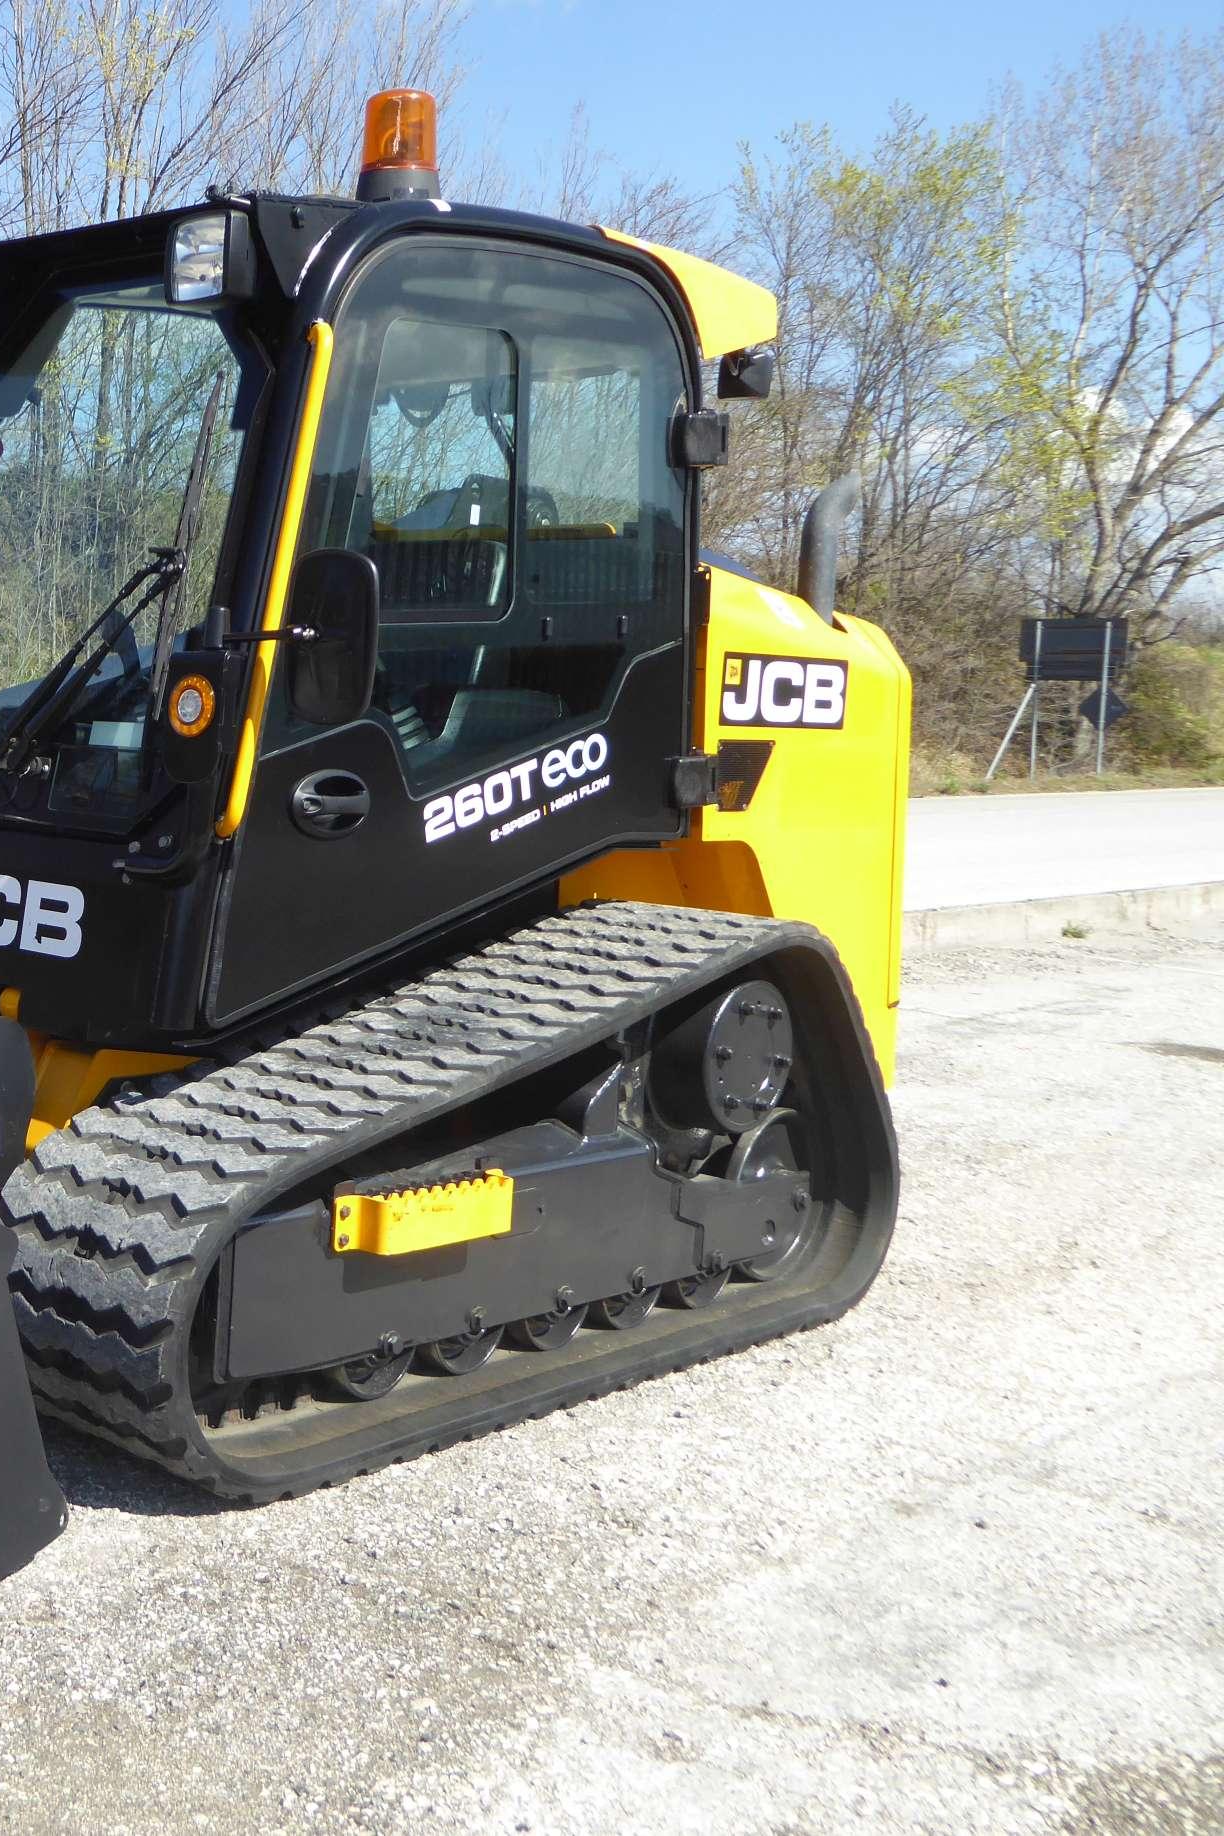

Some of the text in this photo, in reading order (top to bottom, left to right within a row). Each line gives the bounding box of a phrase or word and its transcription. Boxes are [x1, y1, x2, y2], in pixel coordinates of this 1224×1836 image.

[722, 659, 845, 724] JCB
[550, 790, 578, 813] HIGH
[579, 774, 610, 799] FLOW
